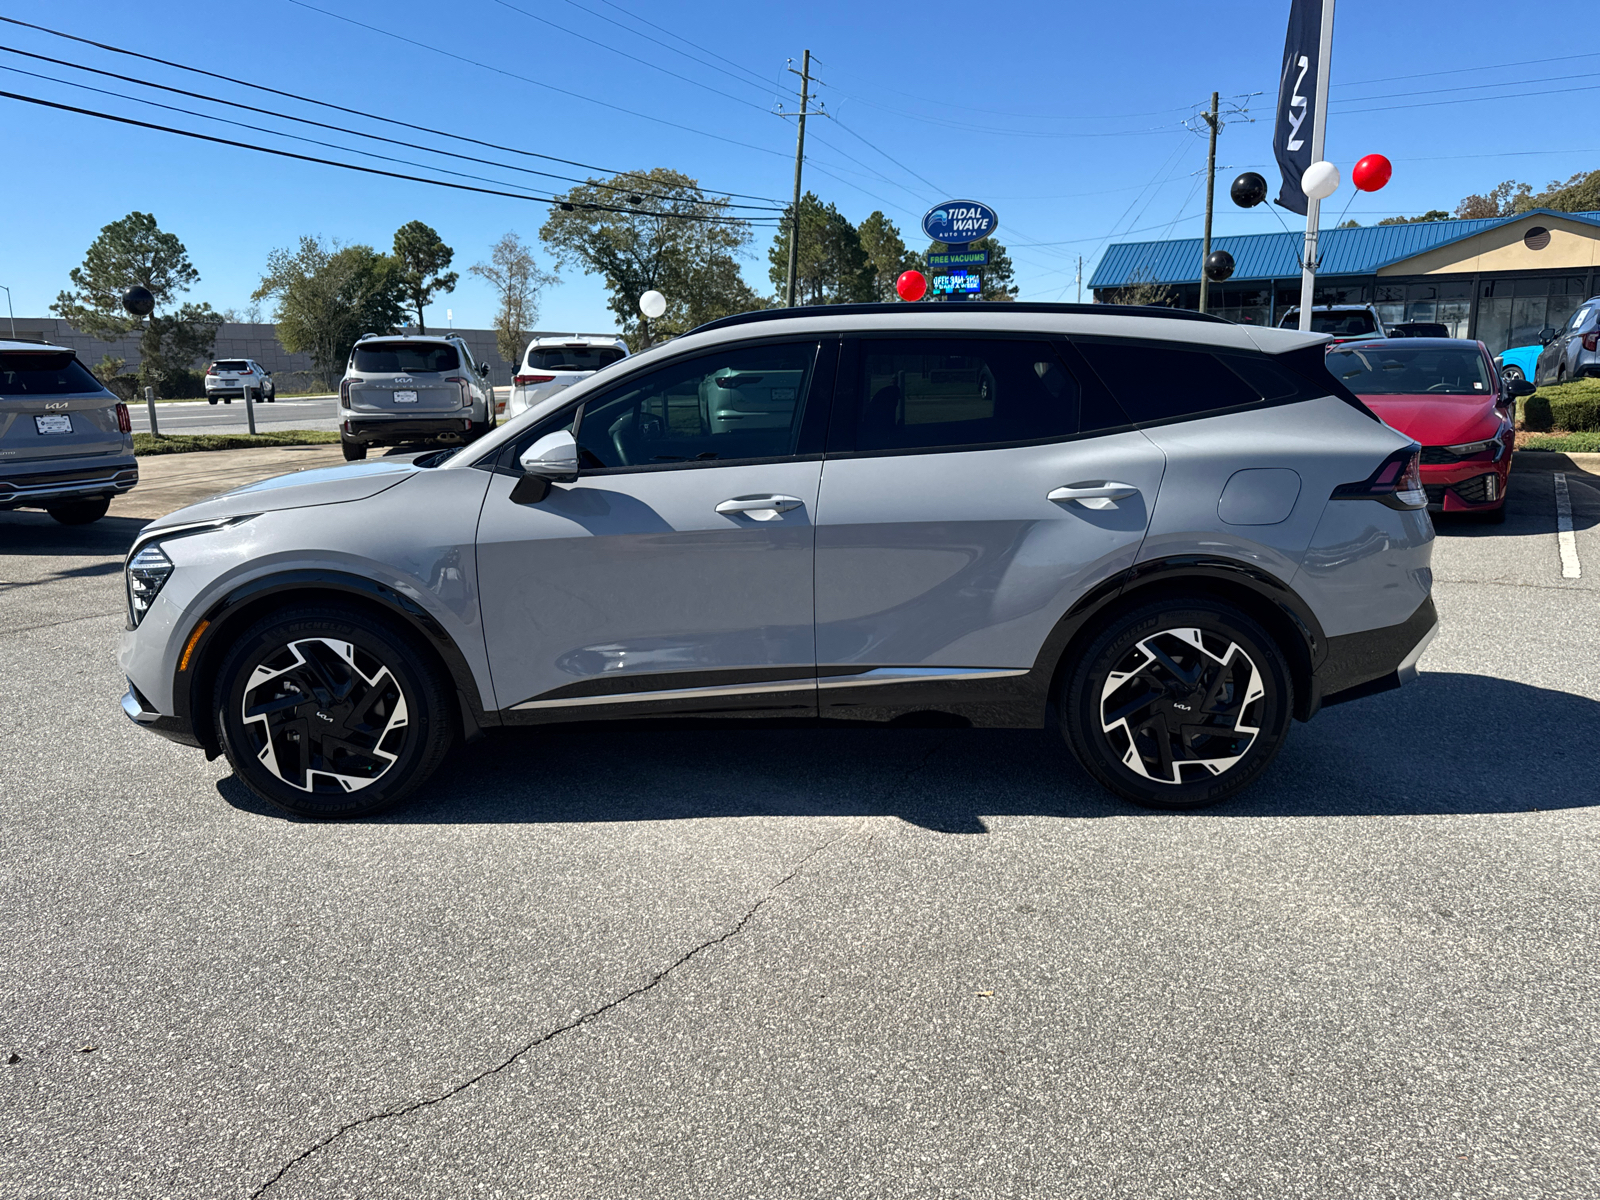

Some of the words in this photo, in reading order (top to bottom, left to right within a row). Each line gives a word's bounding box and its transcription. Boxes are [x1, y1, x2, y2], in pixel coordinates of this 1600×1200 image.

[1286, 55, 1309, 151] KIA
[948, 208, 982, 219] TIDAL
[953, 218, 989, 230] WAVE
[930, 255, 948, 264] FREE
[950, 253, 985, 263] VACUUMS
[45, 402, 69, 410] KIA
[288, 621, 352, 634] MICHELIN
[1104, 617, 1157, 657] MICHELIN
[1173, 702, 1191, 711] KIA
[316, 711, 333, 723] KIA
[296, 800, 357, 812] MICHELIN
